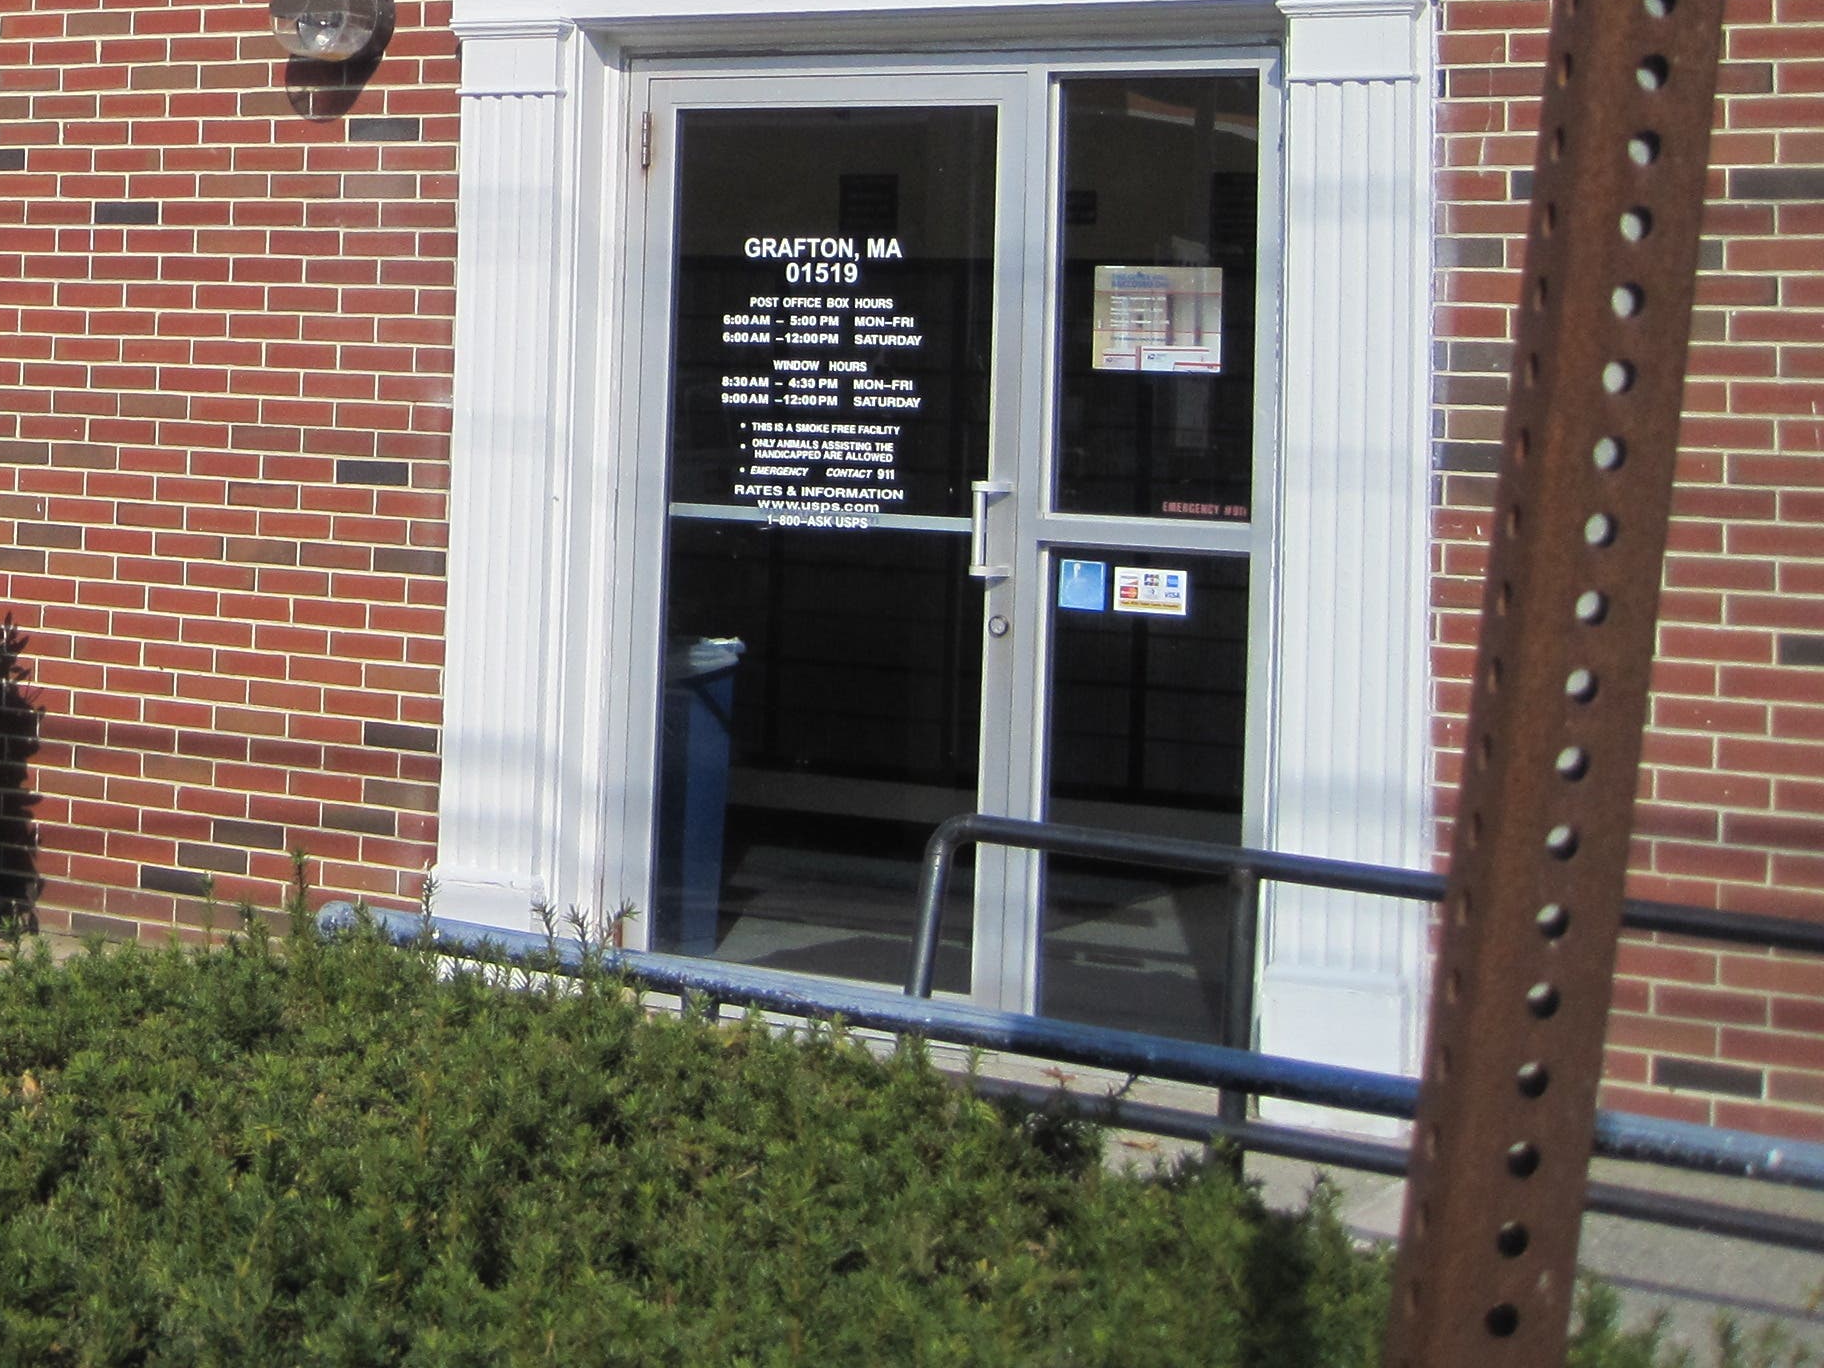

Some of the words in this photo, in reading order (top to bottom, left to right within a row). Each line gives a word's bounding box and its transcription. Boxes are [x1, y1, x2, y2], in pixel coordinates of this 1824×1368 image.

[744, 237, 860, 261] GRAFTON,
[867, 237, 903, 259] MA
[785, 263, 859, 283] 01519
[749, 296, 779, 308] POST
[782, 297, 822, 309] OFFICE
[826, 298, 850, 309] BOX
[854, 298, 894, 309] HOURS
[819, 316, 840, 327] PM
[854, 334, 923, 346] SATURDAY
[772, 359, 820, 371] WINDOW
[828, 360, 867, 372] HOURS
[818, 378, 839, 389] PM
[853, 396, 922, 408] SATURDAY
[751, 421, 773, 432] THIS
[774, 422, 784, 432] IS
[785, 423, 794, 433] A
[795, 423, 830, 434] SMOKE
[831, 424, 856, 434] FREE
[857, 425, 900, 435] FACILITY
[752, 438, 776, 449] ONLY
[776, 439, 819, 450] ANIMALS
[821, 440, 872, 451] ASSISTING
[874, 442, 894, 452] THE
[754, 449, 821, 460] HANDICAPPED
[822, 450, 843, 461] ARE
[845, 451, 894, 463] ALLOWED
[749, 465, 809, 477] EMERGENCY
[825, 467, 873, 479] CONTACT
[876, 468, 895, 480] 911
[734, 484, 783, 496] RATES
[786, 485, 797, 497] &
[800, 486, 904, 500] INFORMATION
[835, 516, 869, 529] USPS
